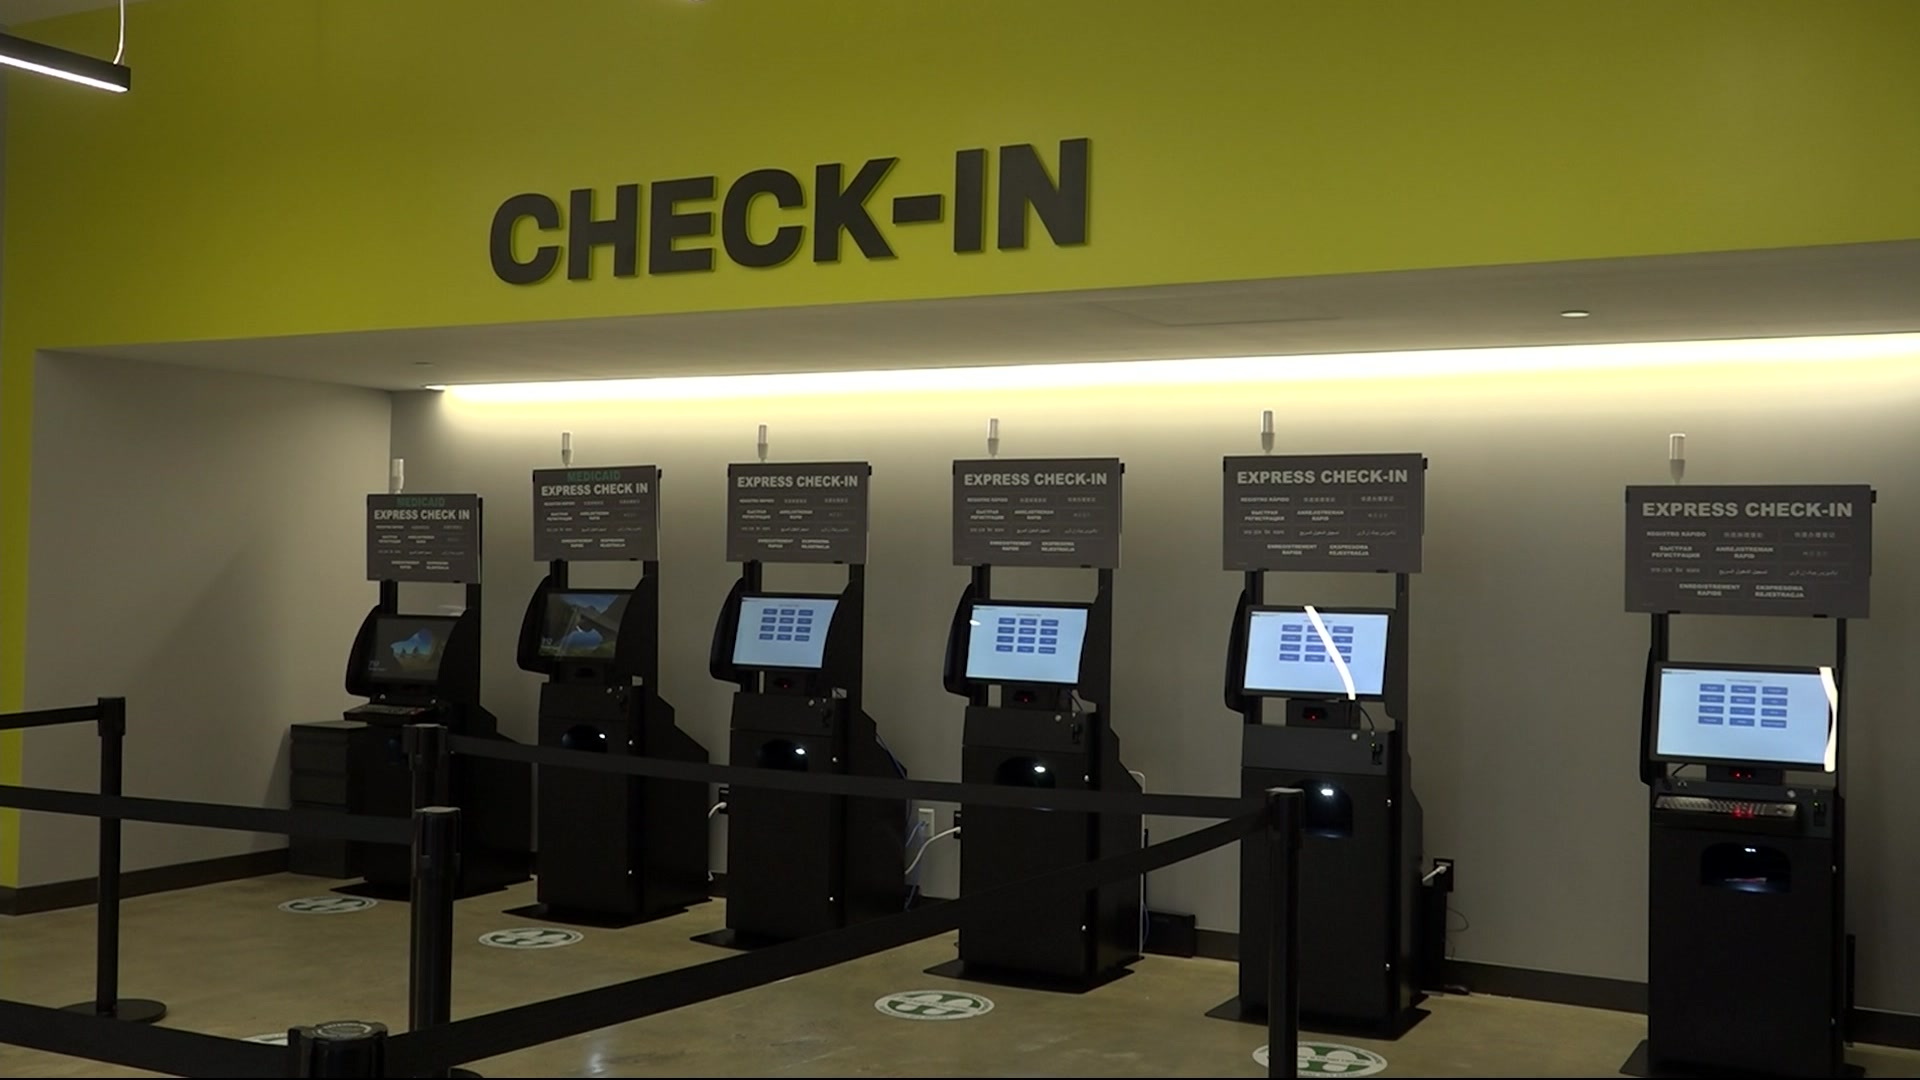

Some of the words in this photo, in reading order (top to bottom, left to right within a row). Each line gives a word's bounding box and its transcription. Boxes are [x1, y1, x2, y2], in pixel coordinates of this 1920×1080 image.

[490, 138, 1091, 285] CHECK-IN
[567, 471, 621, 481] MEDICAID
[737, 476, 793, 488] EXPRESS
[796, 475, 858, 487] CHECK-IN
[964, 473, 1030, 486] EXPRESS
[1033, 472, 1107, 486] CHECK-IN
[1237, 470, 1316, 484] EXPRESS
[1320, 469, 1408, 484] CHECK-IN
[541, 484, 591, 496] EXPRESS
[593, 483, 633, 495] CHECK
[635, 482, 648, 494] IN
[374, 509, 418, 520] EXPRESS
[420, 509, 456, 520] CHECK
[458, 509, 470, 520] IN
[1642, 502, 1738, 517] EXPRESS
[1745, 502, 1852, 518] CHECK-IN
